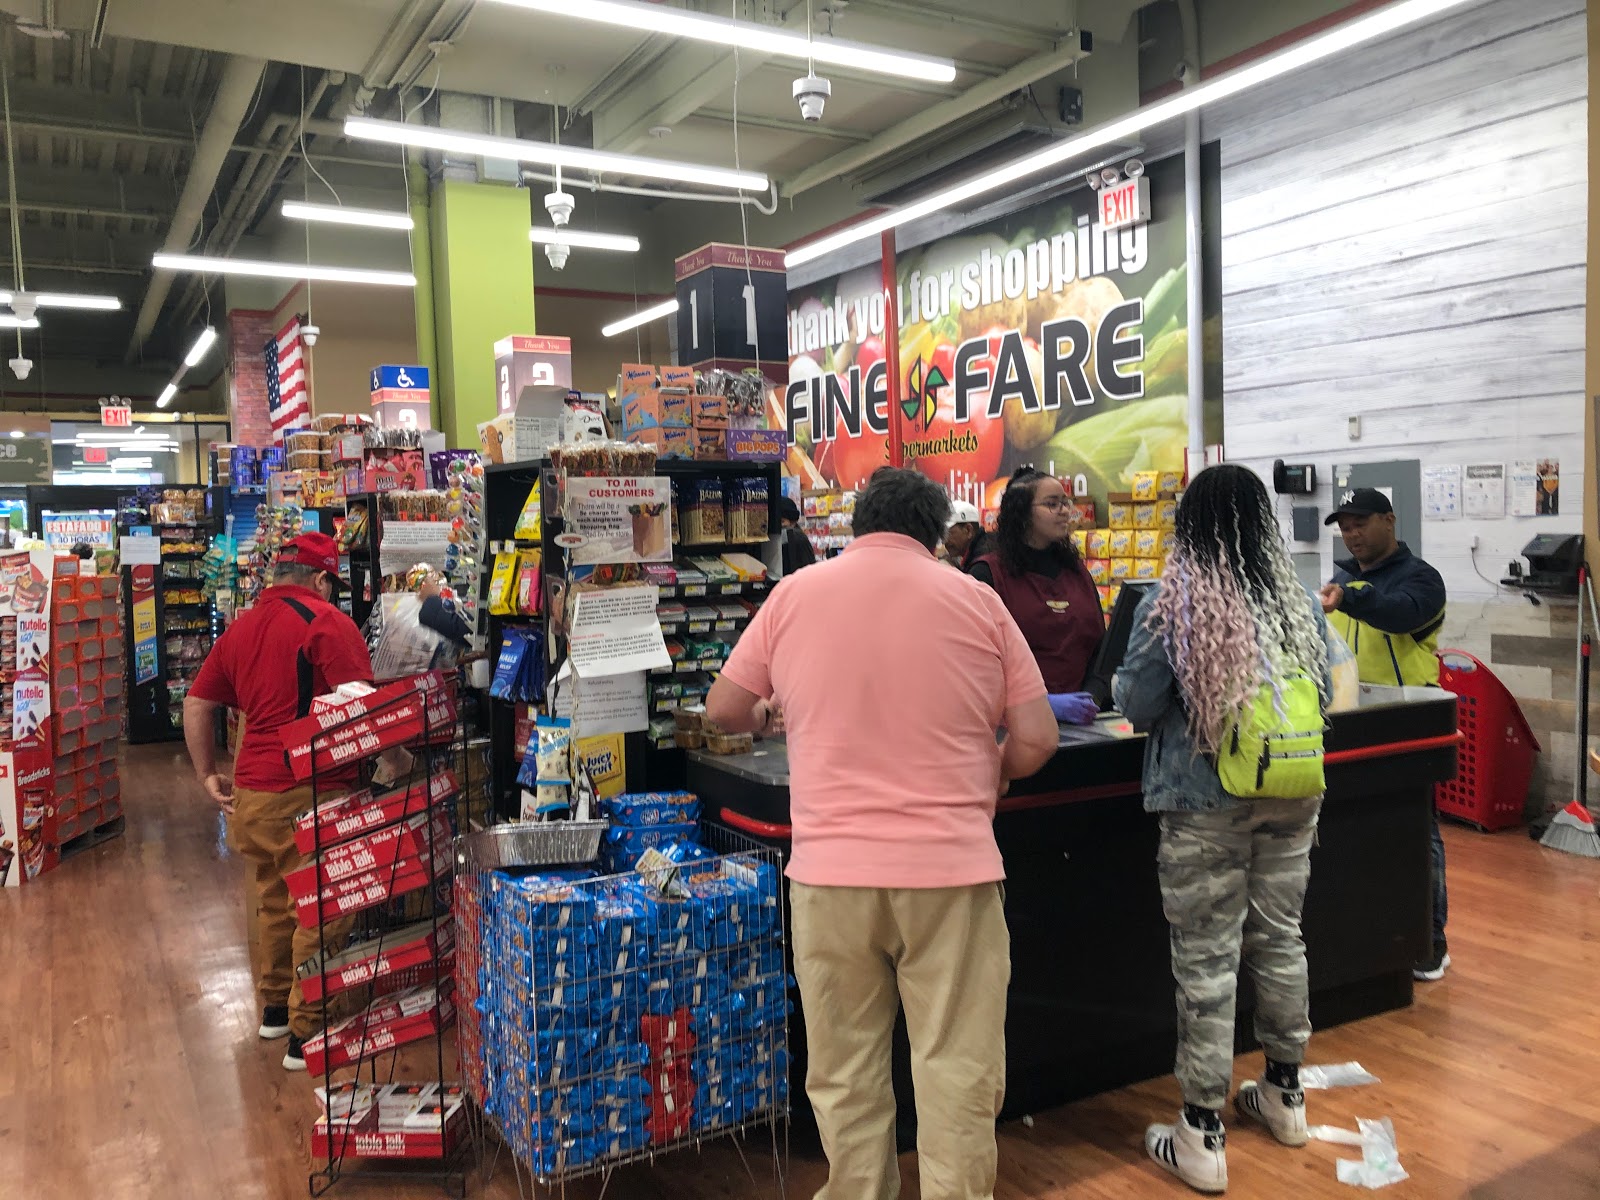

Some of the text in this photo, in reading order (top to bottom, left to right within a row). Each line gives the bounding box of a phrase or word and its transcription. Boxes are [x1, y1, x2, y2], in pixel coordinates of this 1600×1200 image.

[1104, 185, 1135, 226] EXIT
[681, 261, 695, 274] Thank
[727, 251, 773, 267] Thank You
[910, 269, 955, 324] for
[960, 212, 1149, 312] shopping
[690, 289, 699, 349] 1
[742, 284, 757, 345] 1
[524, 340, 560, 351] Thank You
[786, 296, 1145, 447] FINE FARE
[501, 365, 511, 410] 2
[105, 409, 128, 426] EXIT
[753, 441, 780, 456] POPS
[884, 428, 979, 461] Spermarkets
[606, 479, 637, 487] TO All
[589, 489, 655, 498] CUSTOMERS
[70, 535, 100, 544] HORAS
[20, 618, 47, 632] nutella
[16, 685, 44, 700] nutella
[587, 751, 612, 768] Juicy
[17, 766, 51, 787] Breadsticks
